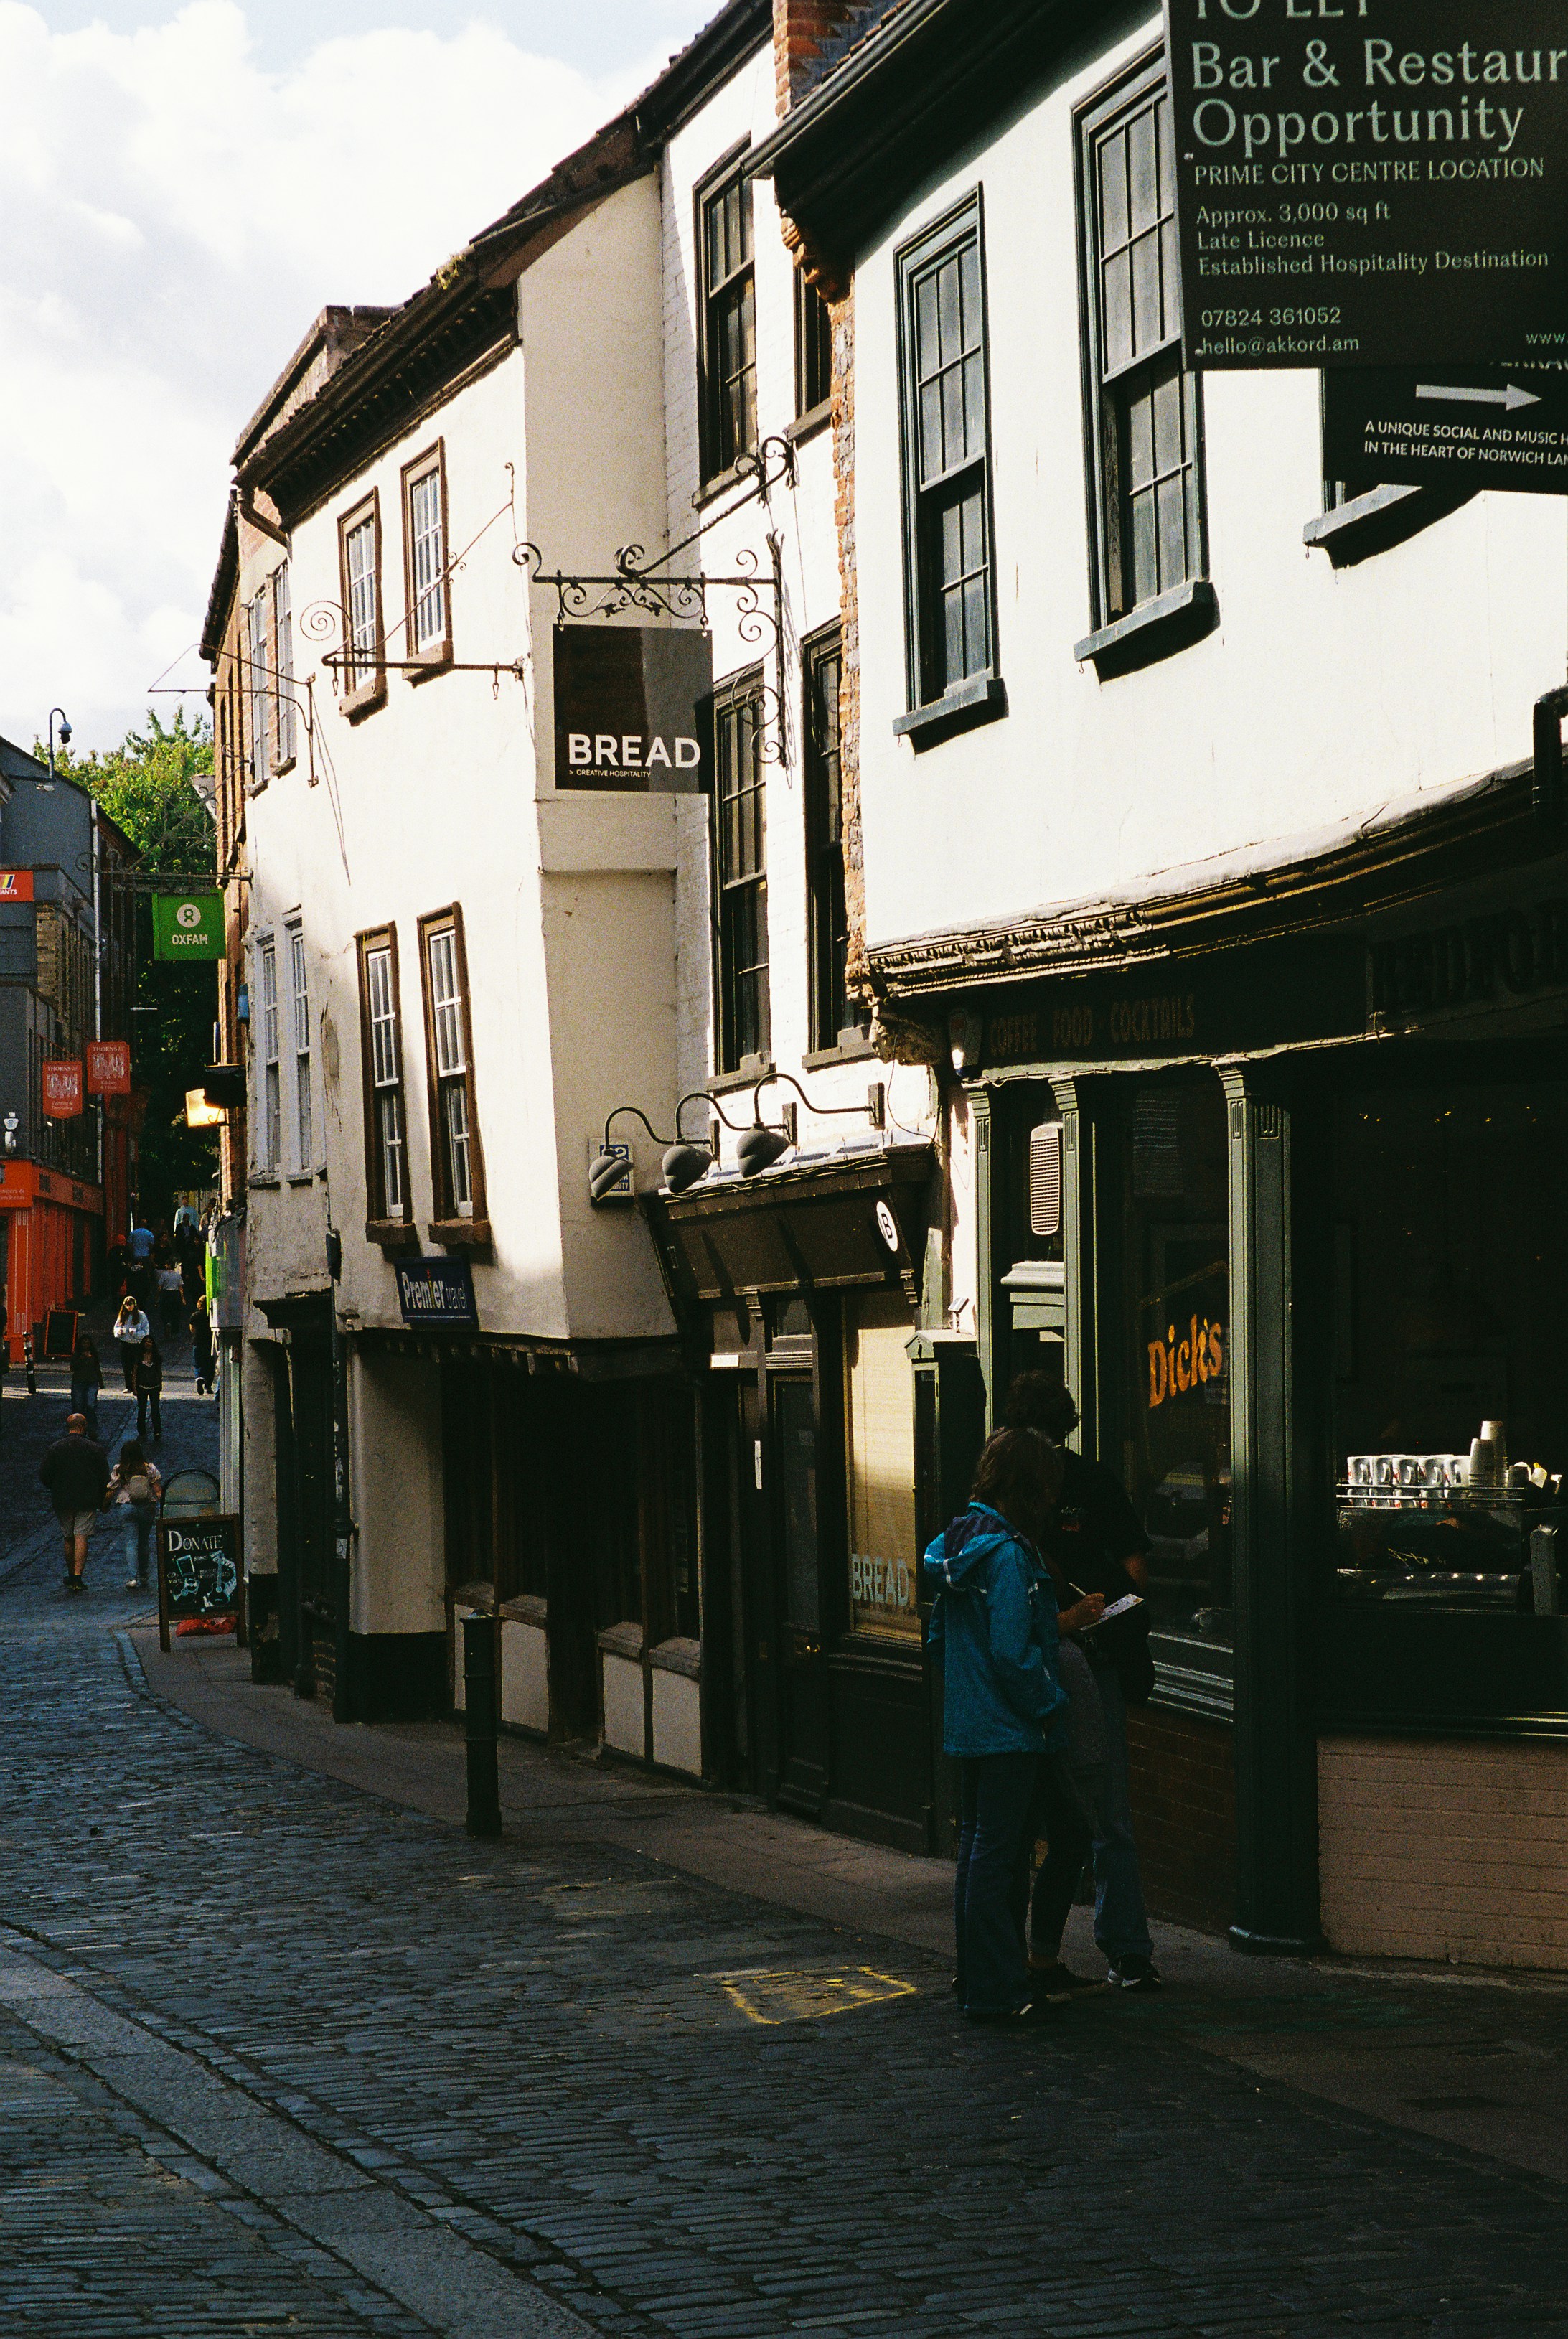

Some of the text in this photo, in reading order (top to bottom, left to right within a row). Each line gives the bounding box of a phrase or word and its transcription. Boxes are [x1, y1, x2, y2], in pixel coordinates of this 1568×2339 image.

[1191, 38, 1568, 89] Bar & Restaur
[1192, 96, 1524, 159] Opportunity
[1195, 157, 1544, 186] PRIME CITY CENTRE LOCATION
[1196, 200, 1391, 229] Approx. 3,000 sq ft
[1198, 230, 1325, 250] Late Licence
[1198, 249, 1549, 277] Established Hospitality Destination
[1201, 306, 1341, 328] 07824 361052
[1202, 333, 1360, 357] hello@akkord.am
[1364, 420, 1374, 433] A
[1378, 421, 1430, 438] UNIQUE
[1433, 424, 1480, 441] SOCIAL
[1483, 428, 1512, 442] AND
[1516, 430, 1557, 445] MUSIC
[1364, 441, 1378, 454] IN
[1381, 441, 1407, 456] THE
[1410, 443, 1455, 459] HEART
[1457, 446, 1475, 459] OF
[1478, 448, 1544, 464] NORWICH
[568, 733, 701, 769] BREAD
[172, 934, 208, 944] OXFAM
[990, 993, 1195, 1056] COFFEE FOOD COCKTAILS
[881, 1213, 893, 1239] B
[400, 1270, 468, 1310] Premier travel
[1148, 1313, 1223, 1408] Dick's
[168, 1530, 223, 1552] DONATE
[851, 1553, 909, 1606] BREAD
